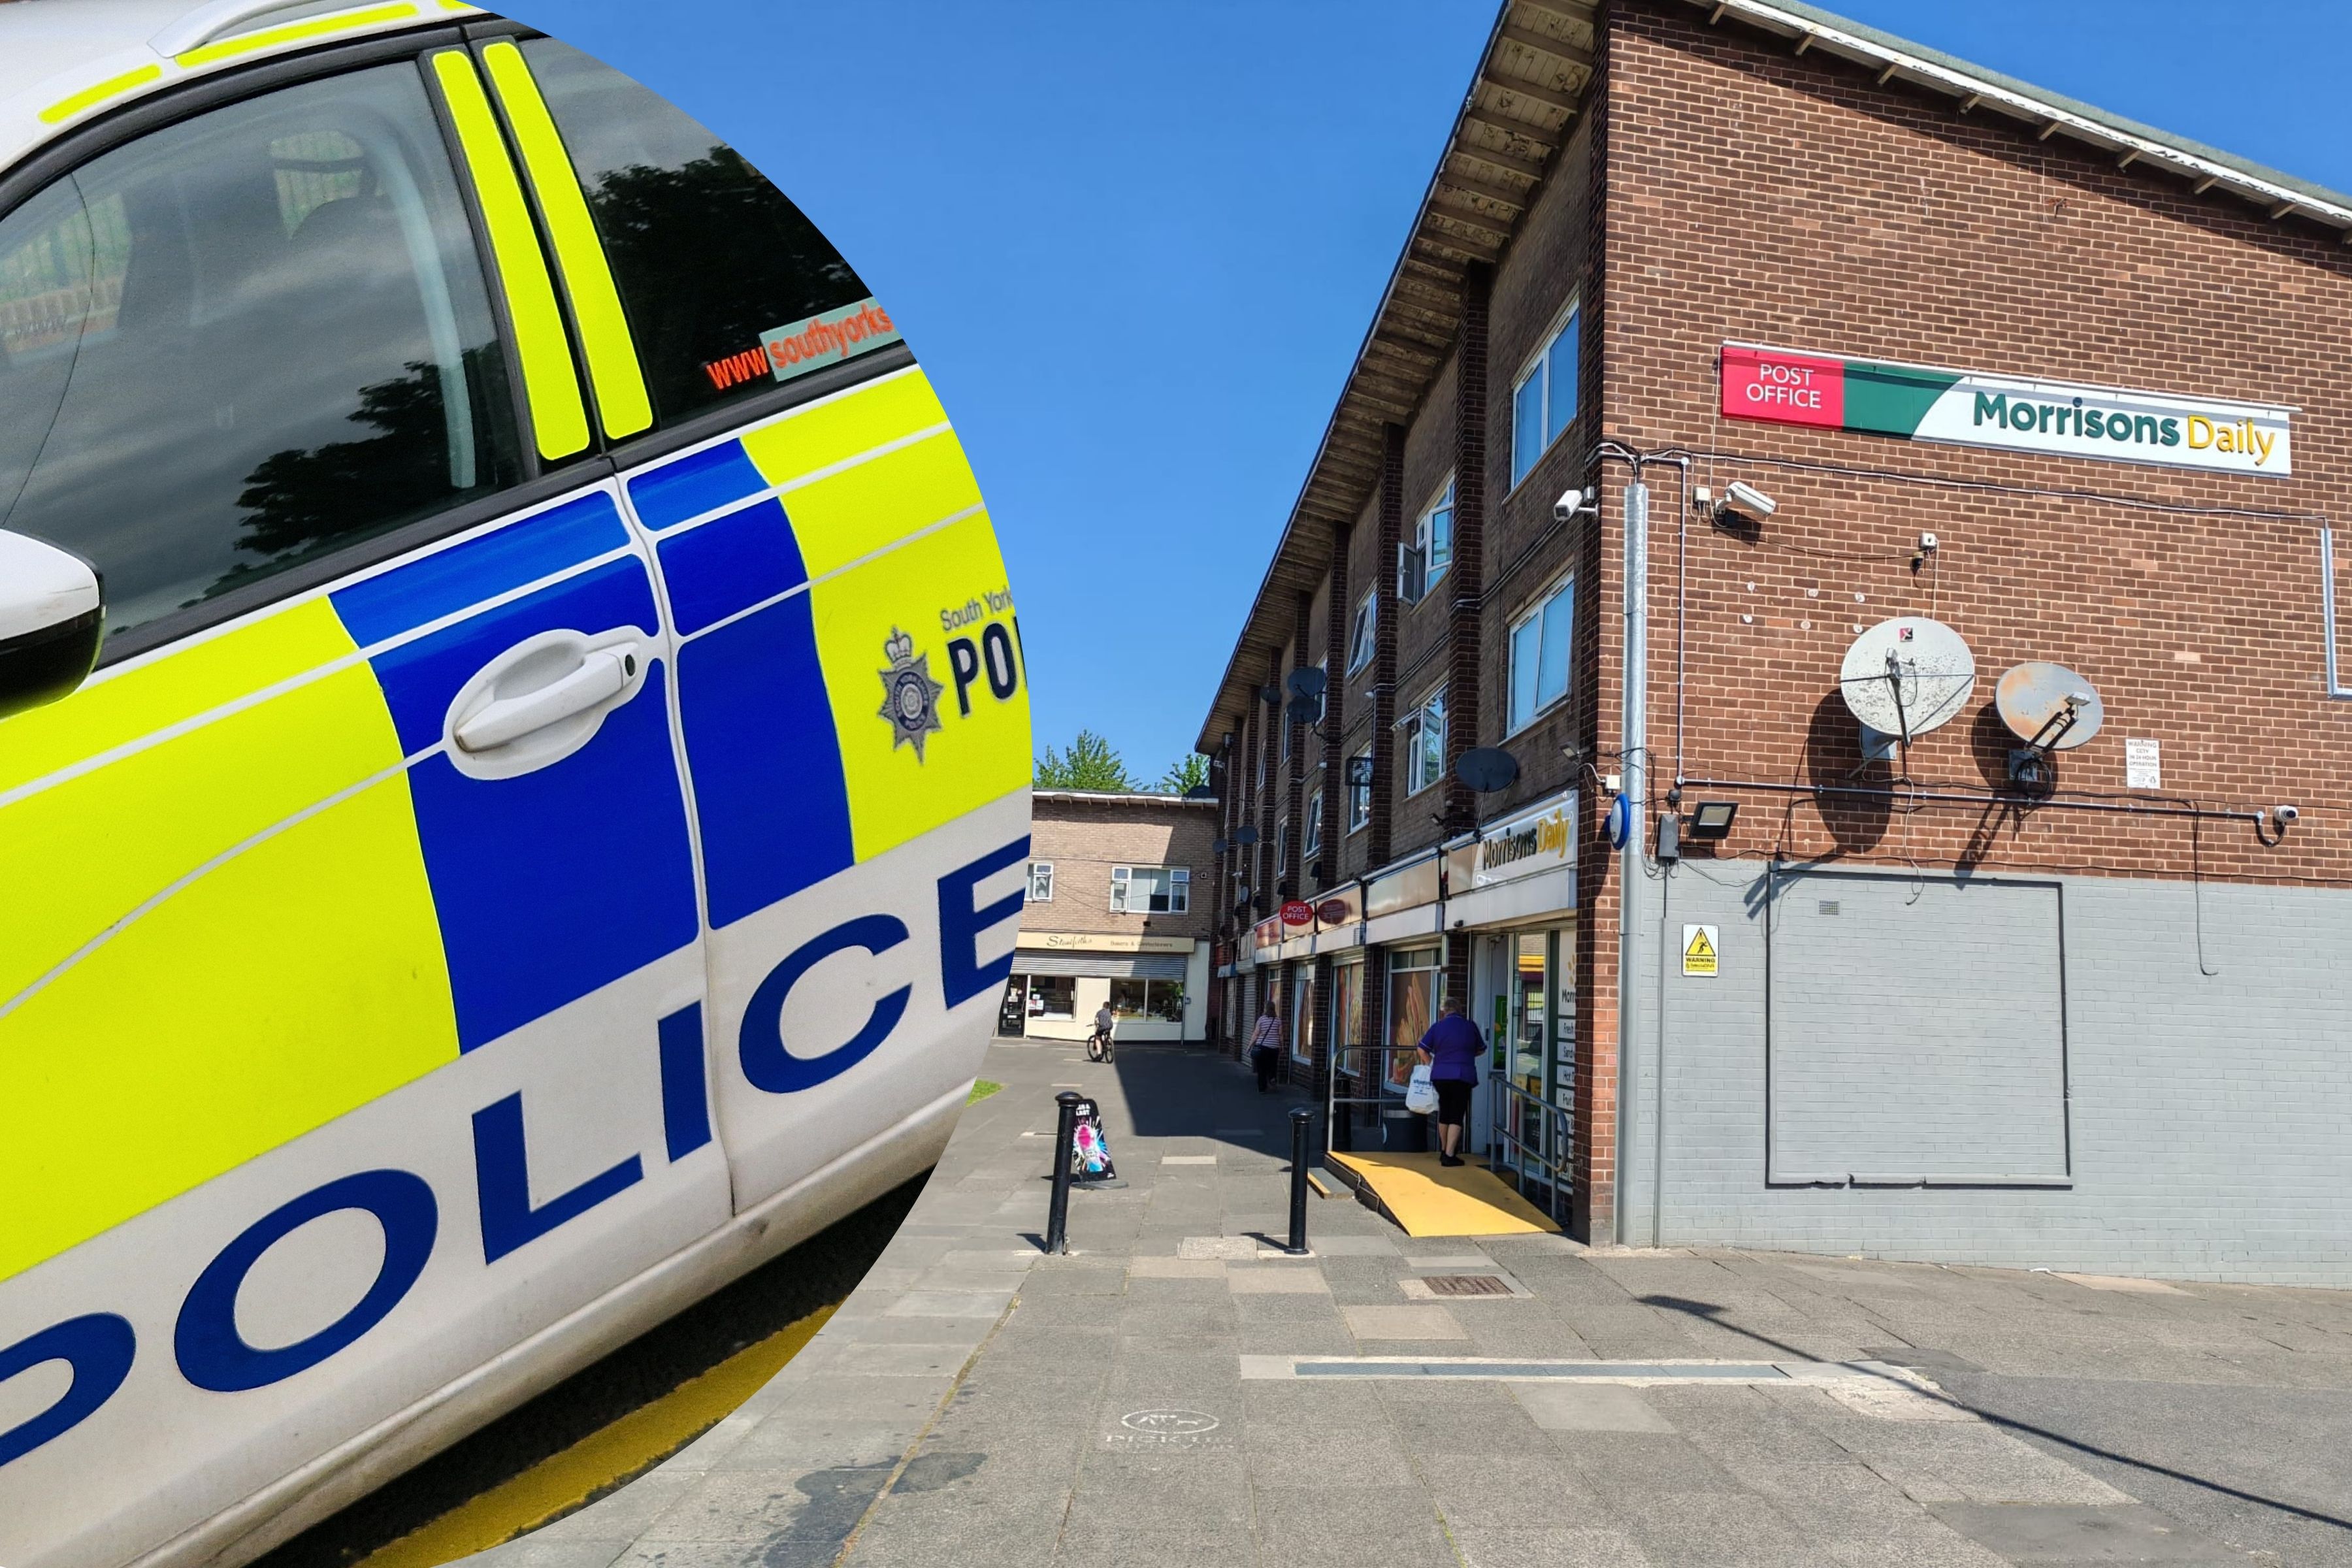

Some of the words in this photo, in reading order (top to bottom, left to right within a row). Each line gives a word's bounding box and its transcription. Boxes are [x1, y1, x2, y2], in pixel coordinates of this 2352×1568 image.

[1746, 383, 1821, 408] OFFICE
[1760, 363, 1814, 386] POST
[1974, 390, 2180, 446] Morrisons
[2187, 414, 2275, 465] Daily
[940, 598, 983, 631] South
[947, 616, 1027, 715] PO
[1483, 827, 1537, 870] Morrisons
[1537, 808, 1569, 858] Daily
[0, 834, 1031, 1467] POLICE
